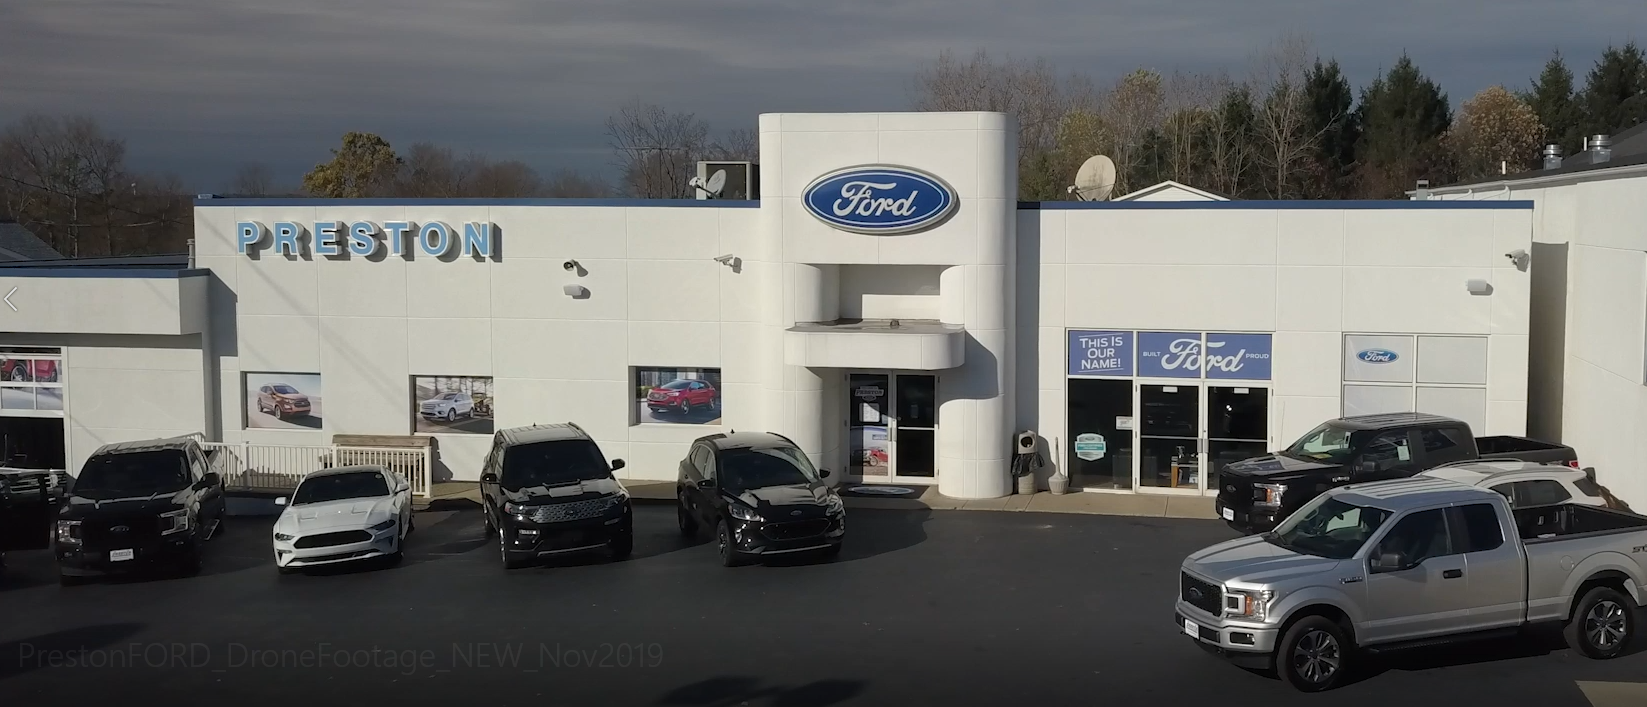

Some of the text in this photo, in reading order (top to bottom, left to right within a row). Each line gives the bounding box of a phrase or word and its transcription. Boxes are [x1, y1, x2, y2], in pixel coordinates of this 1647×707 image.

[833, 181, 919, 216] Ford
[236, 220, 493, 257] PRESTON
[1079, 336, 1123, 348] THIS IS
[1087, 347, 1115, 358] OUR
[1161, 338, 1246, 372] Ford
[1364, 350, 1391, 362] Ford
[1081, 358, 1121, 370] NAME!
